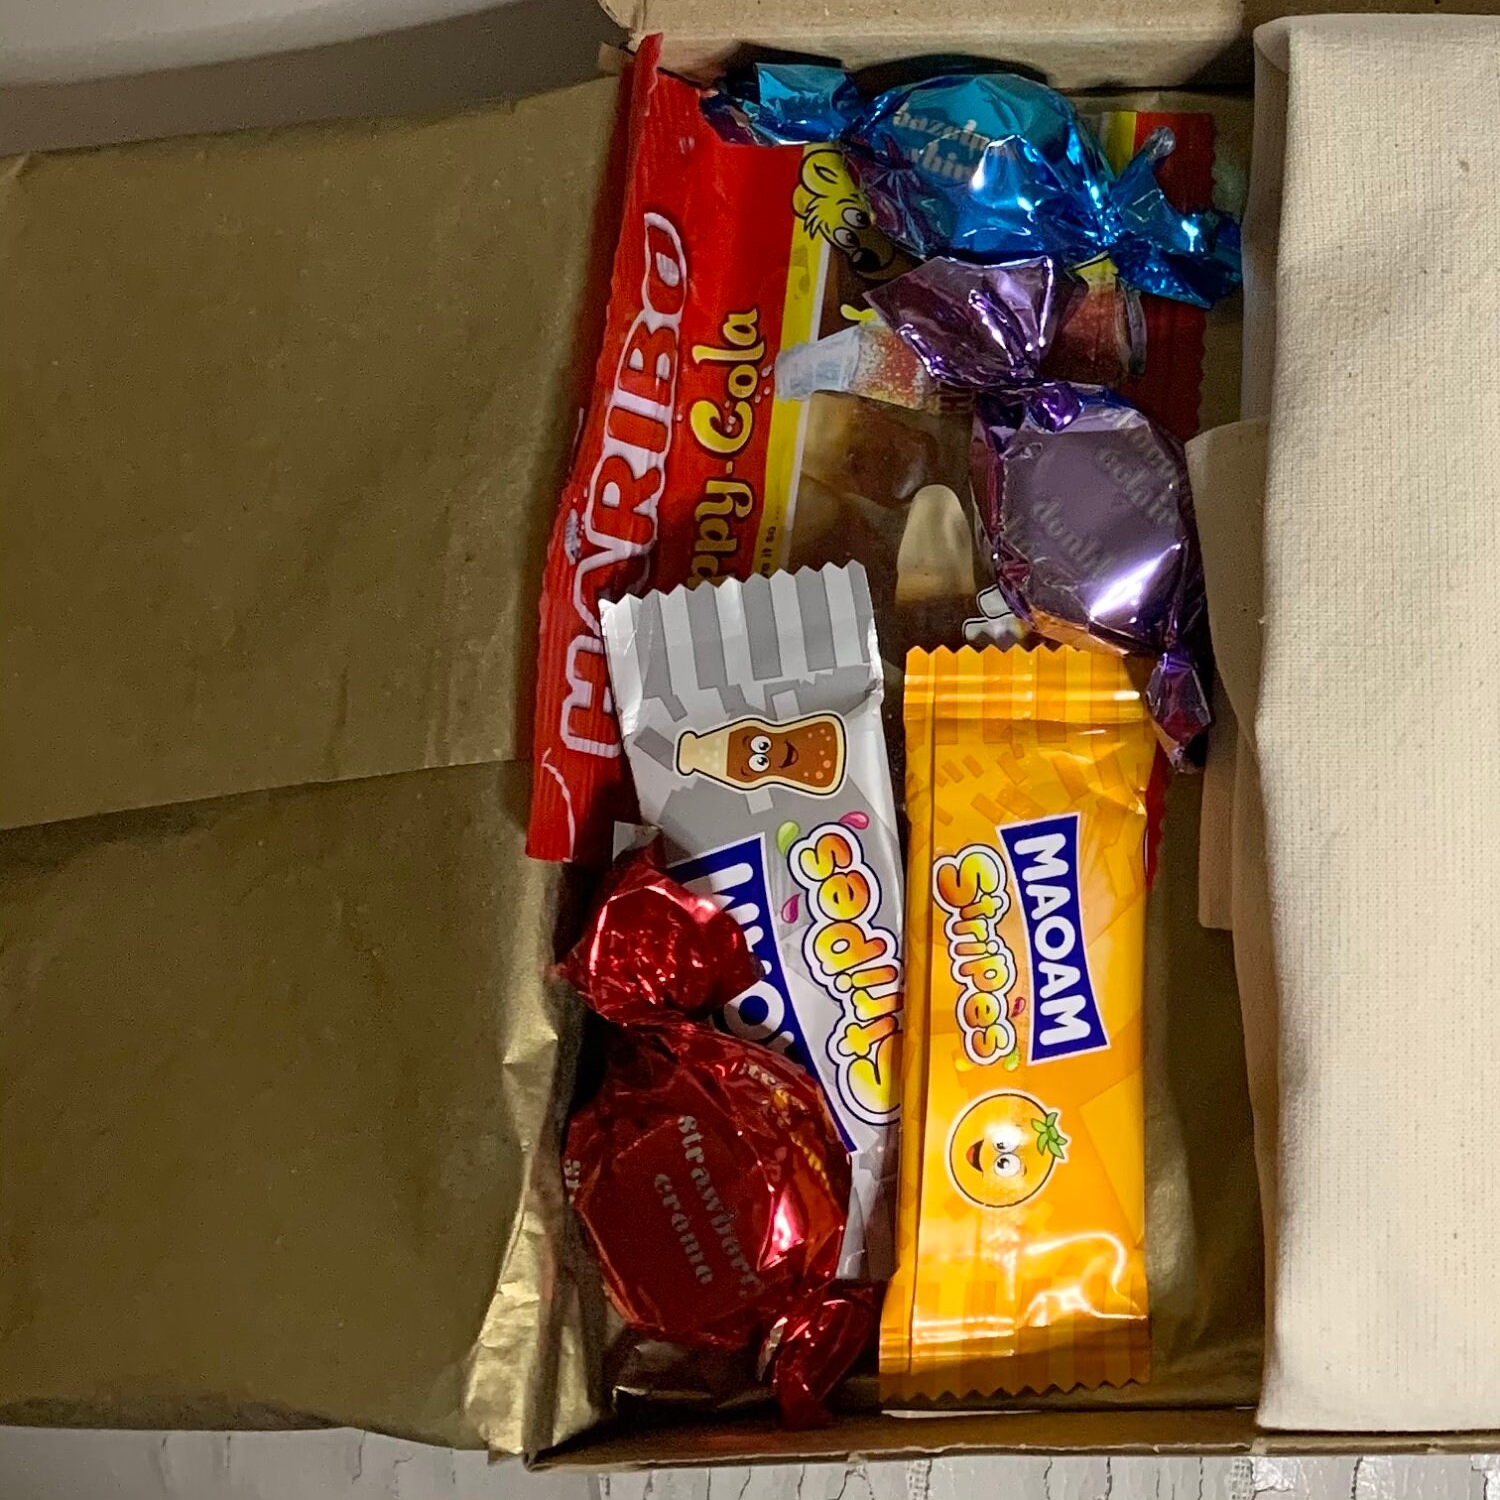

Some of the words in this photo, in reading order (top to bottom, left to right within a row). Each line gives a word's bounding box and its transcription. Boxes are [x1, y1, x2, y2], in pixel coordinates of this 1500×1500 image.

[560, 211, 687, 760] HARIBO
[690, 307, 760, 581] ppy-Cola
[796, 826, 901, 1124] Stripes
[936, 848, 1014, 1065] Stripes
[1011, 831, 1092, 1047] MAOAM
